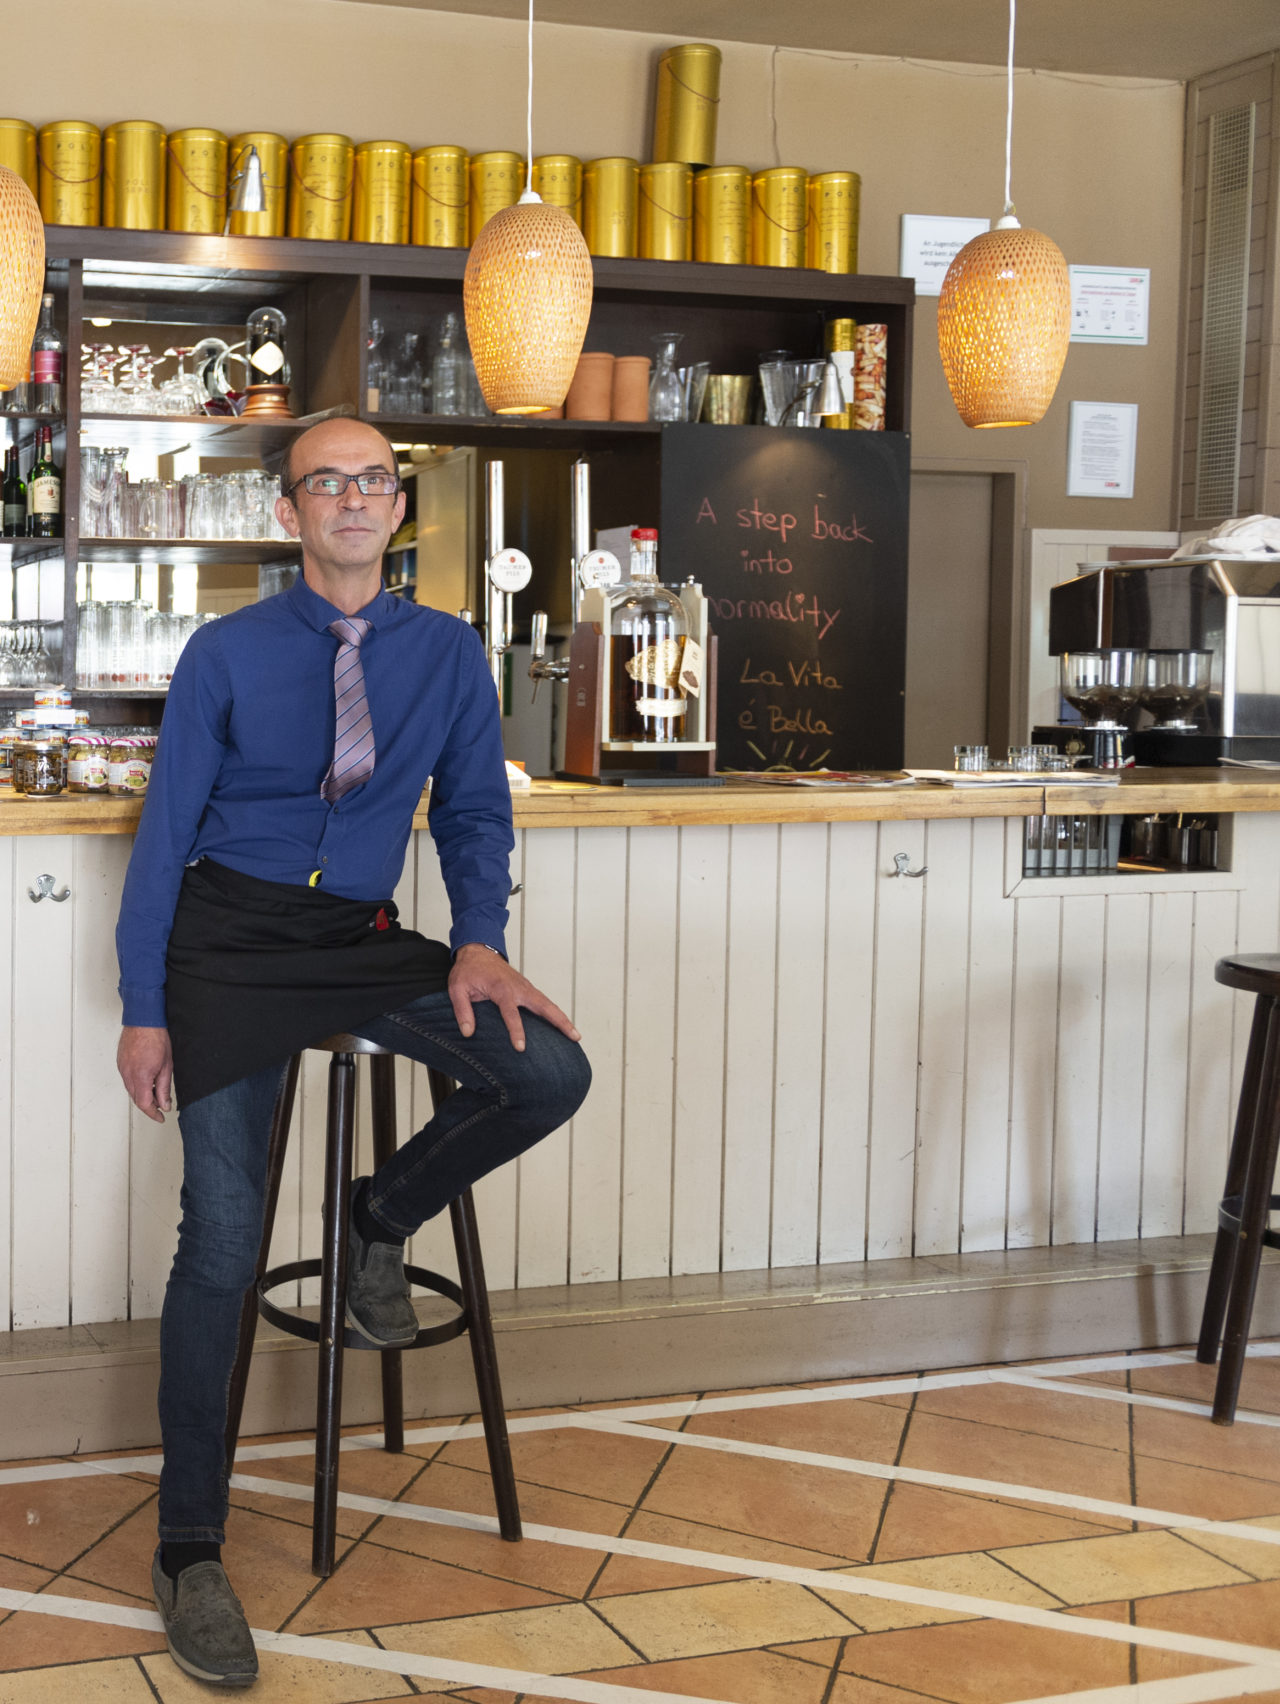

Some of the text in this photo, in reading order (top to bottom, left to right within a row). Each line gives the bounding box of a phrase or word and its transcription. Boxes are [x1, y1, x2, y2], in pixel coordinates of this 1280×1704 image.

[696, 497, 873, 544] A step back
[741, 550, 793, 575] into
[739, 659, 843, 690] La Vita
[767, 705, 834, 736] Bella
